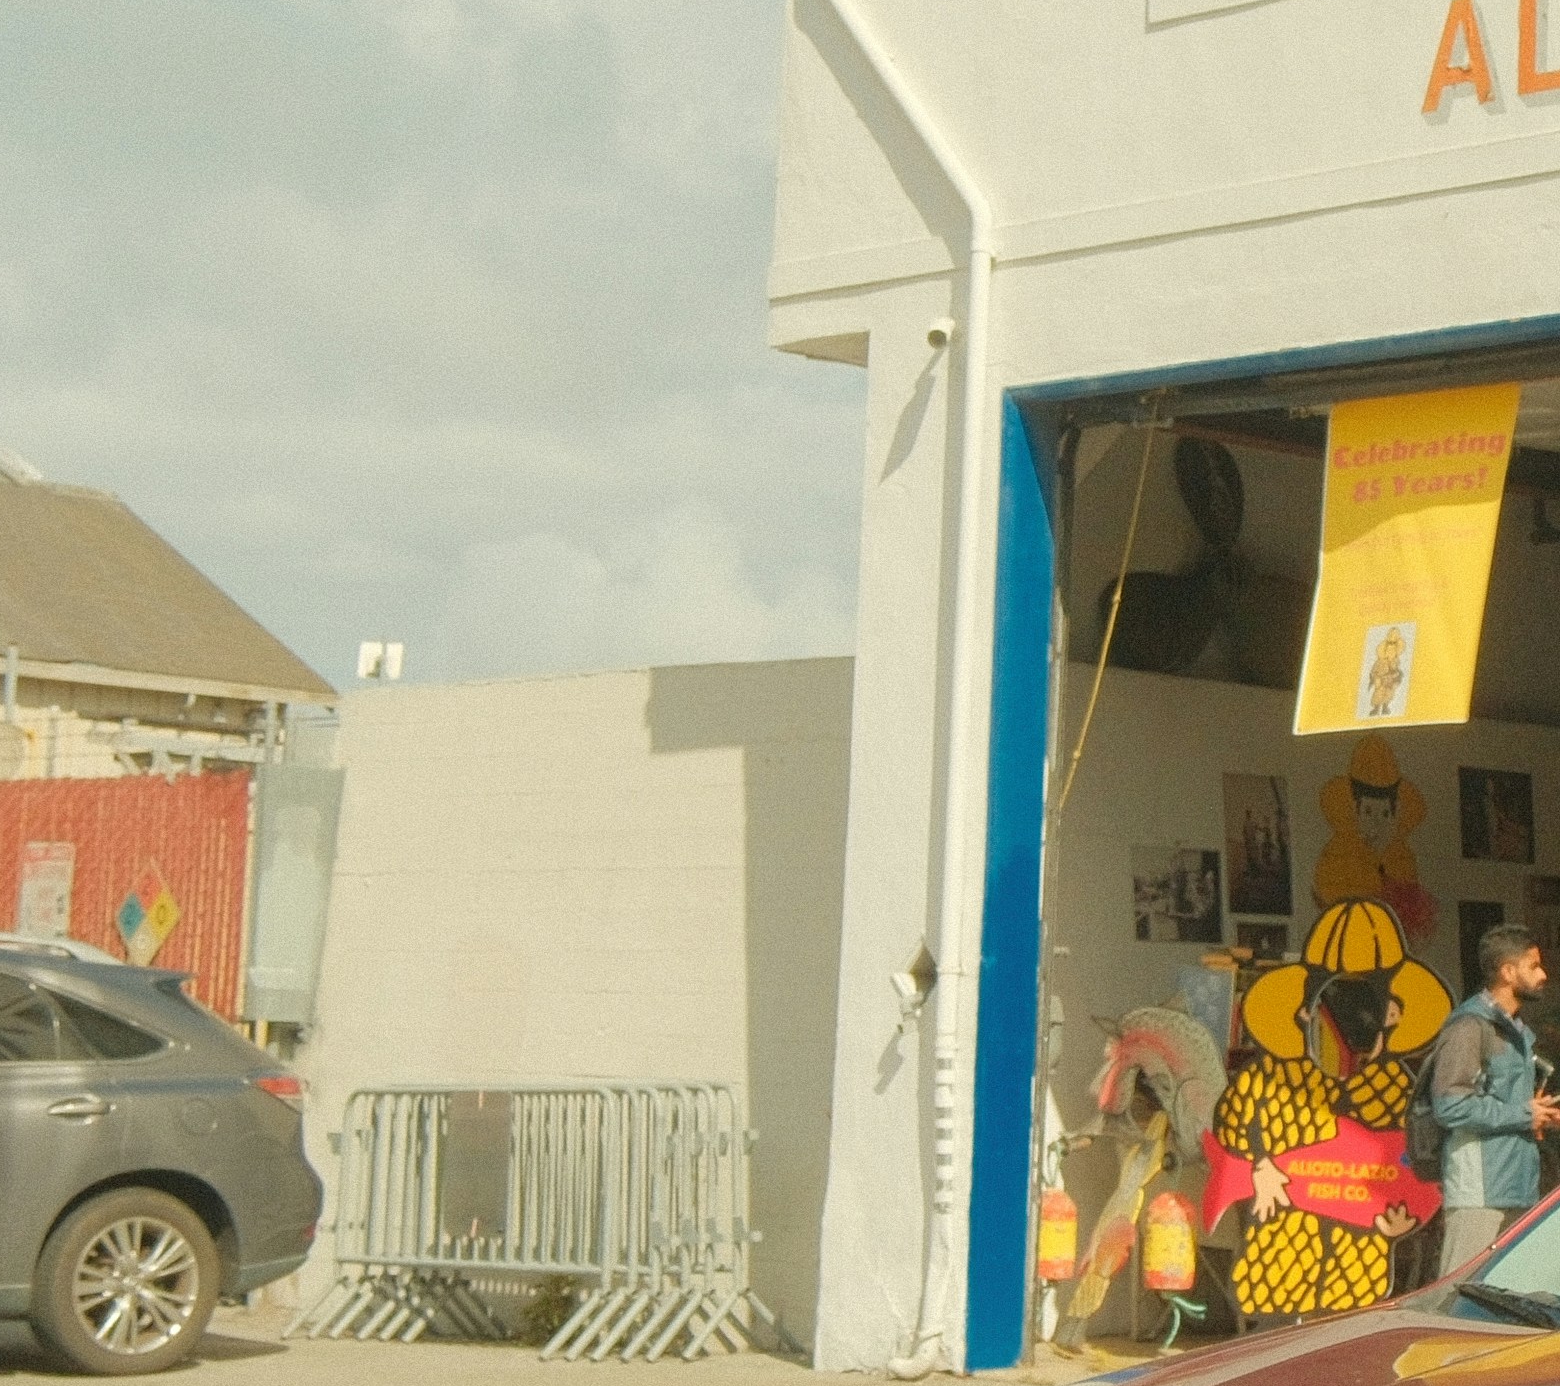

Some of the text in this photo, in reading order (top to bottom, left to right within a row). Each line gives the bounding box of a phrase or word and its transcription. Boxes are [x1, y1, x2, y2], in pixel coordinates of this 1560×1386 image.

[1334, 432, 1507, 469] Celebrating
[1394, 466, 1488, 496] Years!
[1287, 1160, 1399, 1181] ALIOTO-LAZIO
[1307, 1182, 1340, 1200] FISH
